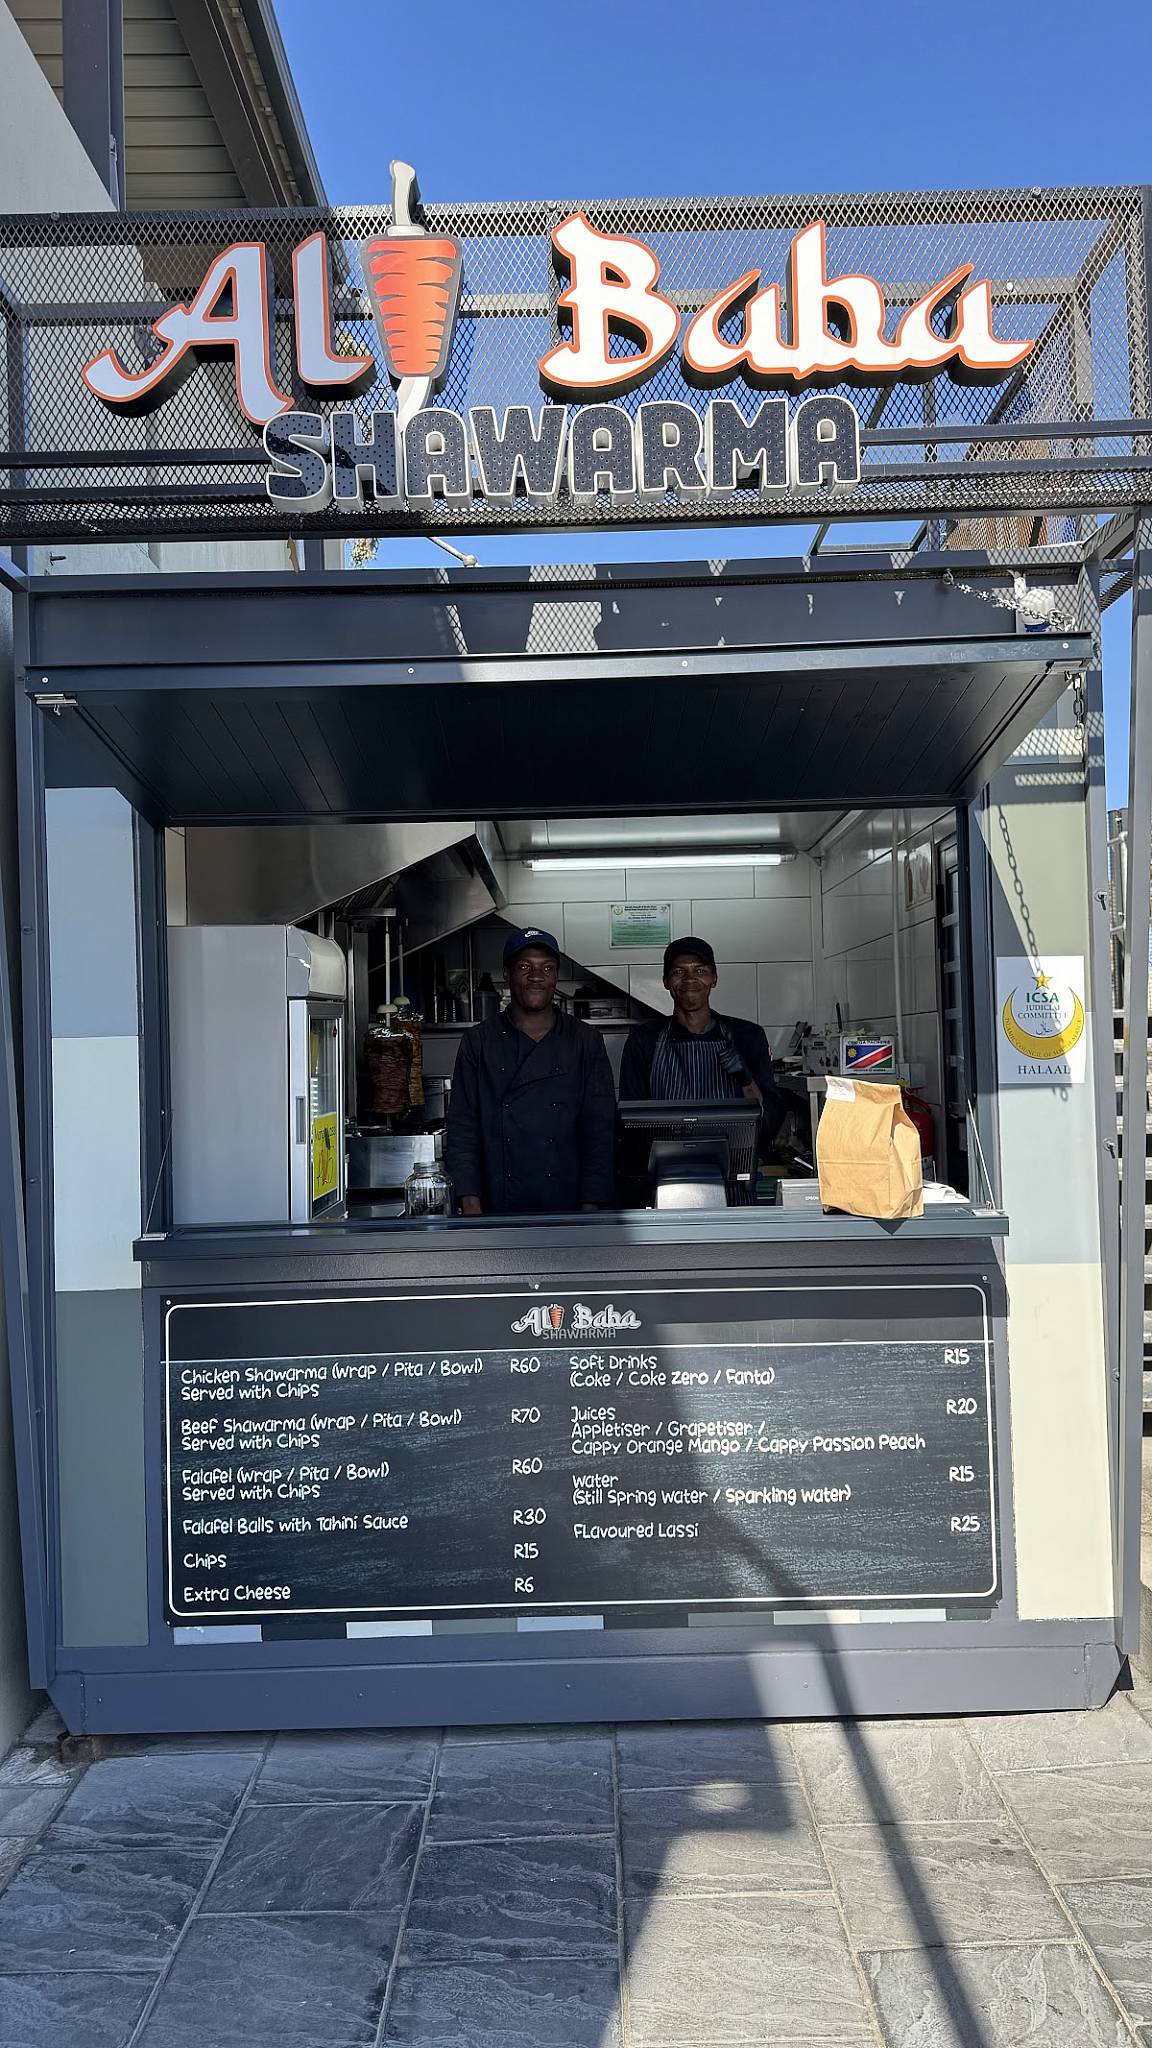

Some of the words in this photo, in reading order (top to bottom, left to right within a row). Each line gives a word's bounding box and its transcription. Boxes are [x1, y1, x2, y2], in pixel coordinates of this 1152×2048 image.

[538, 211, 1035, 392] Baba
[262, 395, 861, 513] SHAWARMA
[1026, 992, 1059, 1003] ICSA
[1017, 1064, 1071, 1075] HALAAL
[571, 1303, 642, 1330] Baba
[542, 1328, 616, 1340] SHAWARMA
[510, 1356, 541, 1373] R60
[569, 1355, 604, 1370] Soft
[609, 1354, 657, 1370] Drinks
[944, 1348, 970, 1365] R15
[181, 1368, 240, 1385] Chicken
[245, 1366, 327, 1382] Shawarma
[394, 1362, 423, 1377] Pita
[440, 1357, 483, 1376] Bowl)
[570, 1371, 611, 1388] (Coke
[628, 1370, 666, 1386] Coke
[725, 1367, 775, 1385] Fanta)
[181, 1385, 234, 1401] Served
[238, 1384, 271, 1399] with
[276, 1383, 320, 1400] Chips
[511, 1406, 541, 1424] R70
[571, 1405, 616, 1423] Juices
[946, 1398, 977, 1415] R20
[181, 1418, 218, 1435] Beef
[223, 1417, 305, 1433] Shawarma
[373, 1412, 401, 1428] Pita
[419, 1408, 462, 1427] Bowl)
[571, 1422, 650, 1439] Appletiser
[667, 1420, 753, 1437] Grapetiser
[181, 1435, 234, 1451] Served
[239, 1434, 272, 1450] with
[277, 1433, 320, 1450] Chips
[571, 1439, 621, 1456] Cappy
[626, 1438, 683, 1456] Orange
[688, 1438, 740, 1456] Mango
[758, 1436, 808, 1454] Cappy
[813, 1435, 875, 1452] Passion
[879, 1433, 926, 1450] Peach
[182, 1467, 232, 1484] Falafel
[300, 1466, 329, 1481] Pita
[346, 1461, 390, 1481] Bowl)
[512, 1457, 543, 1474] R60
[949, 1465, 975, 1482] R15
[182, 1485, 235, 1501] Served
[240, 1484, 273, 1500] with
[277, 1483, 321, 1500] Chips
[572, 1488, 603, 1506] (Still
[607, 1489, 657, 1507] Spring
[725, 1486, 797, 1506] Sparkling
[183, 1518, 233, 1535] Falafel
[237, 1517, 274, 1534] Balls
[279, 1516, 311, 1532] with
[316, 1515, 358, 1532] Tahini
[363, 1514, 409, 1530] Sauce
[513, 1507, 546, 1525] R30
[950, 1515, 981, 1532] R25
[658, 1522, 699, 1538] Lassi
[514, 1542, 539, 1559] R15
[183, 1553, 227, 1570] Chips
[183, 1586, 230, 1602] Extra
[234, 1585, 291, 1601] Cheese
[515, 1576, 534, 1593] R6
